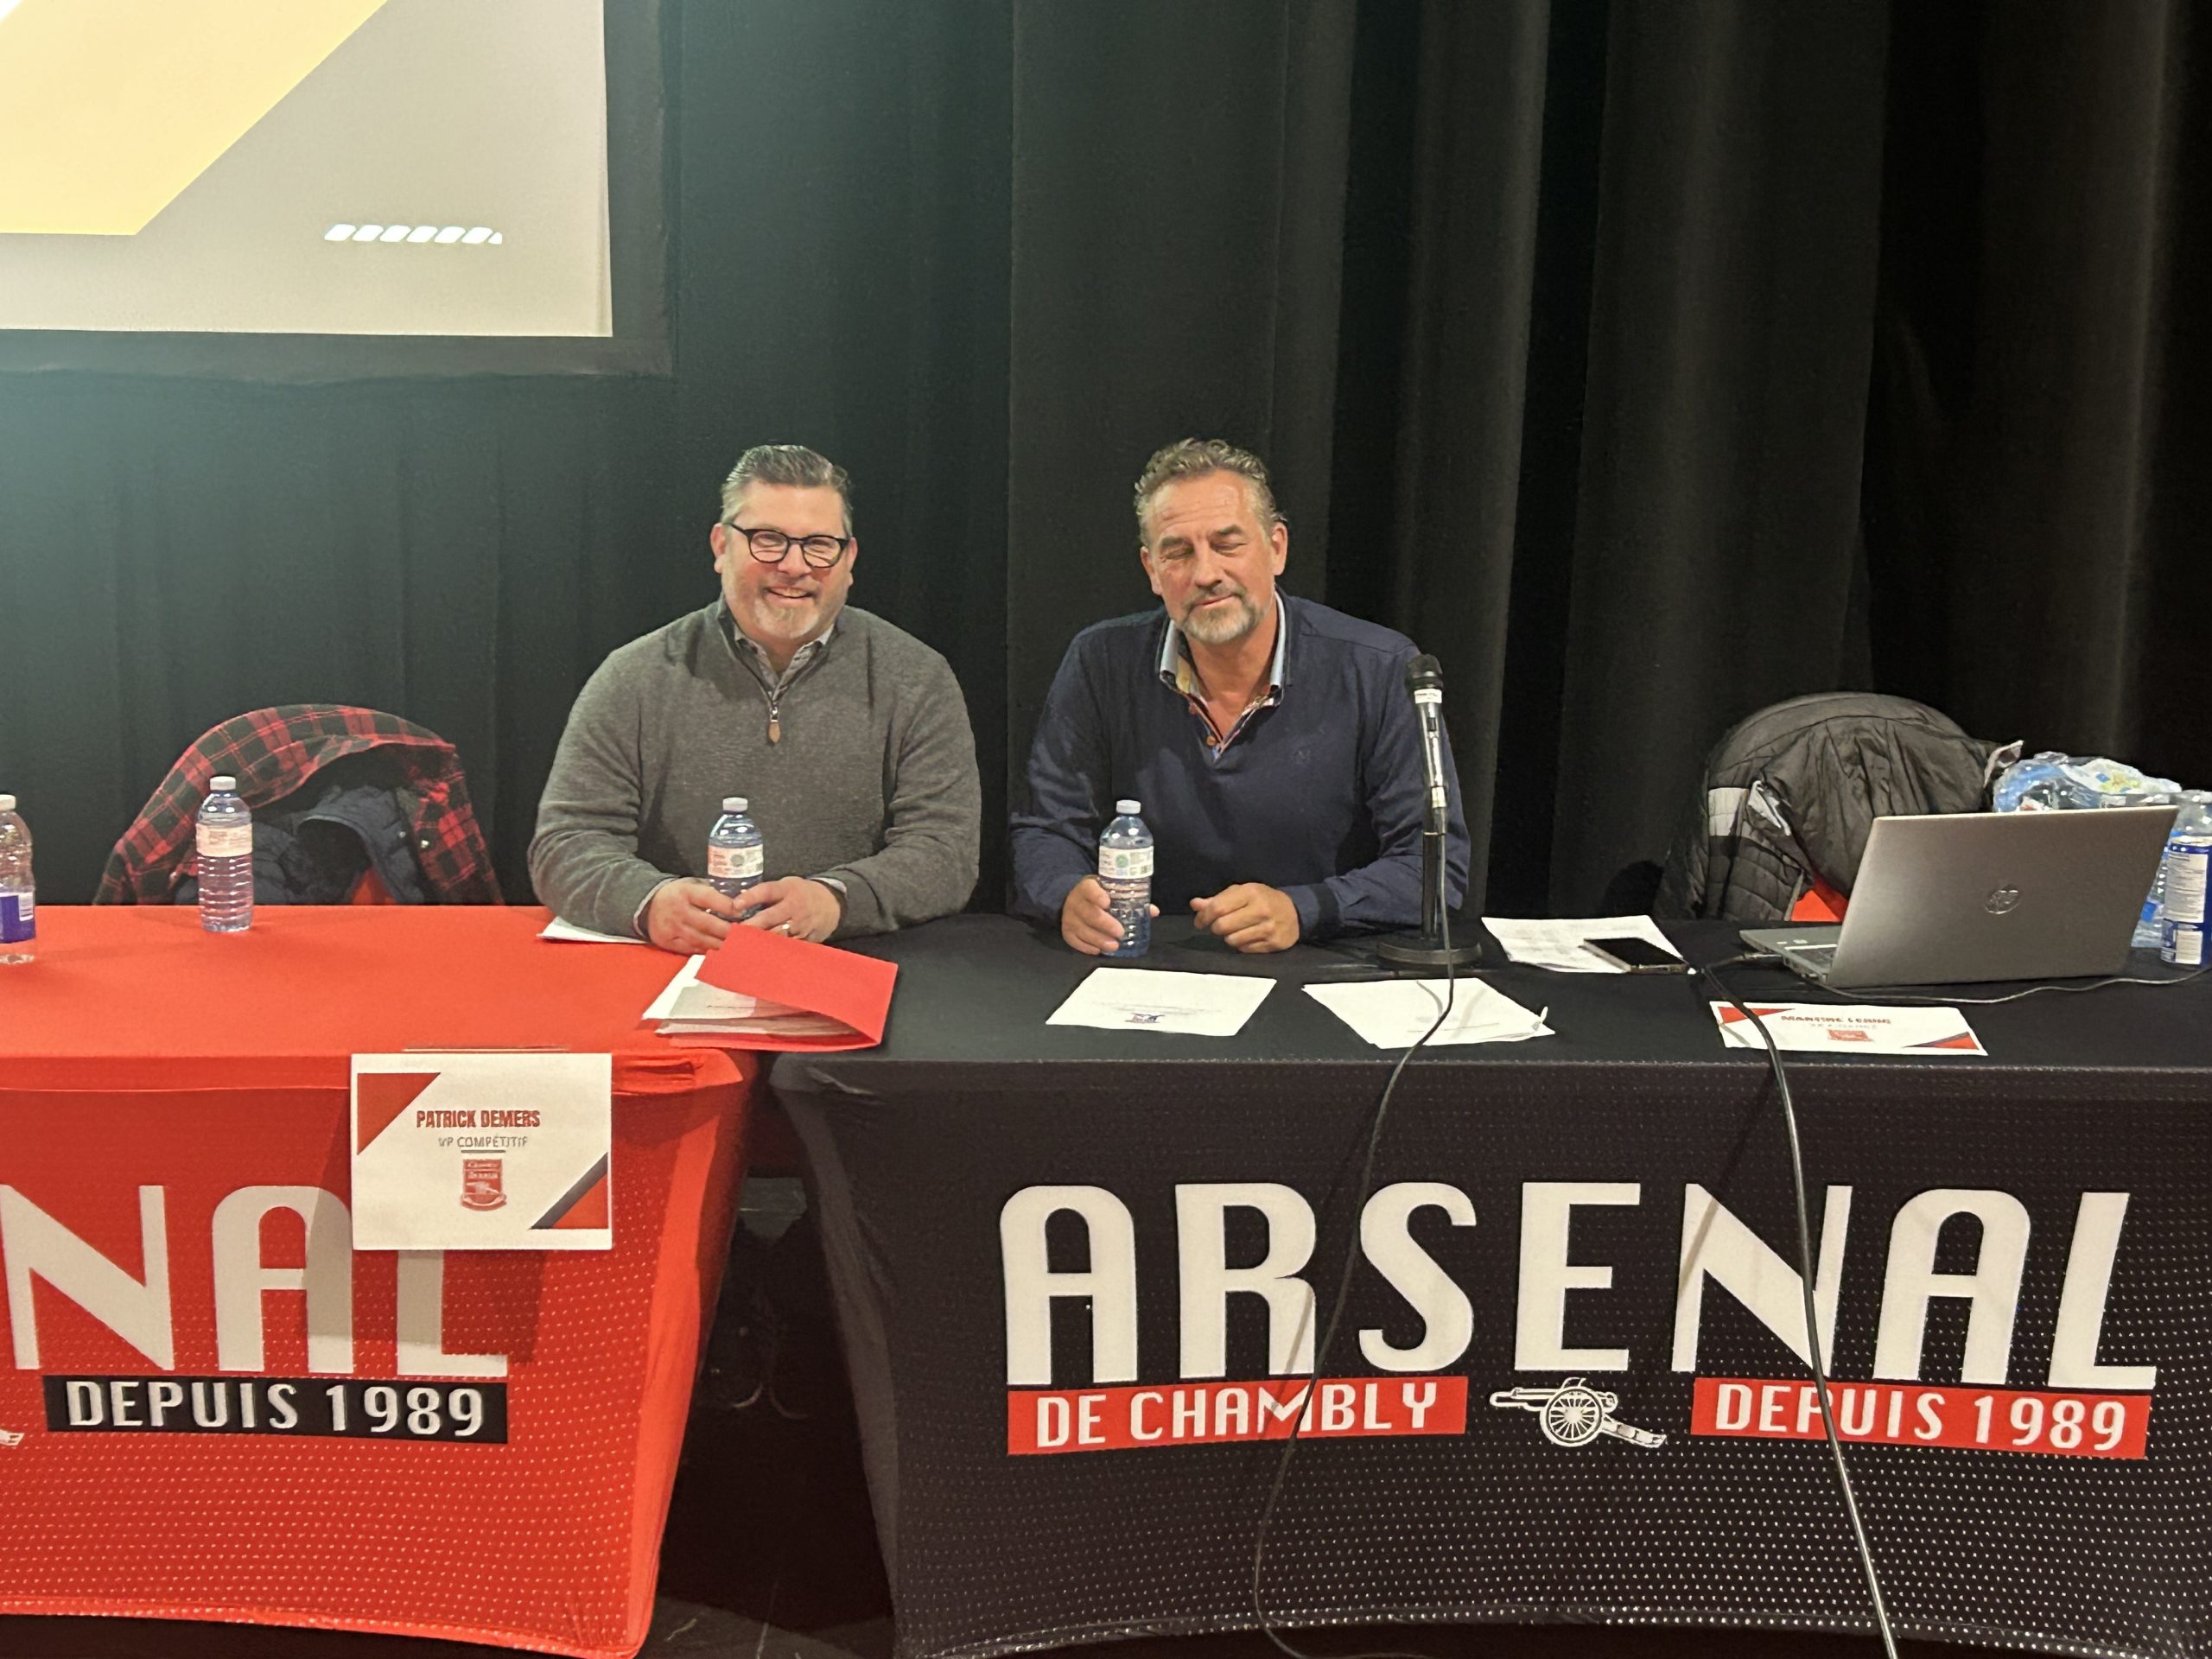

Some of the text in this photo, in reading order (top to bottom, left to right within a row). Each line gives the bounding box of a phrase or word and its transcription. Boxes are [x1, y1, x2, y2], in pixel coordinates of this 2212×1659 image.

[416, 1110, 540, 1128] PATRICK DEMERS
[1000, 1181, 2157, 1389] ARSENAL
[66, 1380, 482, 1437] DEPUIS 1989
[1037, 1382, 1437, 1447] DE CHAMBLY
[1715, 1383, 2126, 1452] DEPUIS 1989
